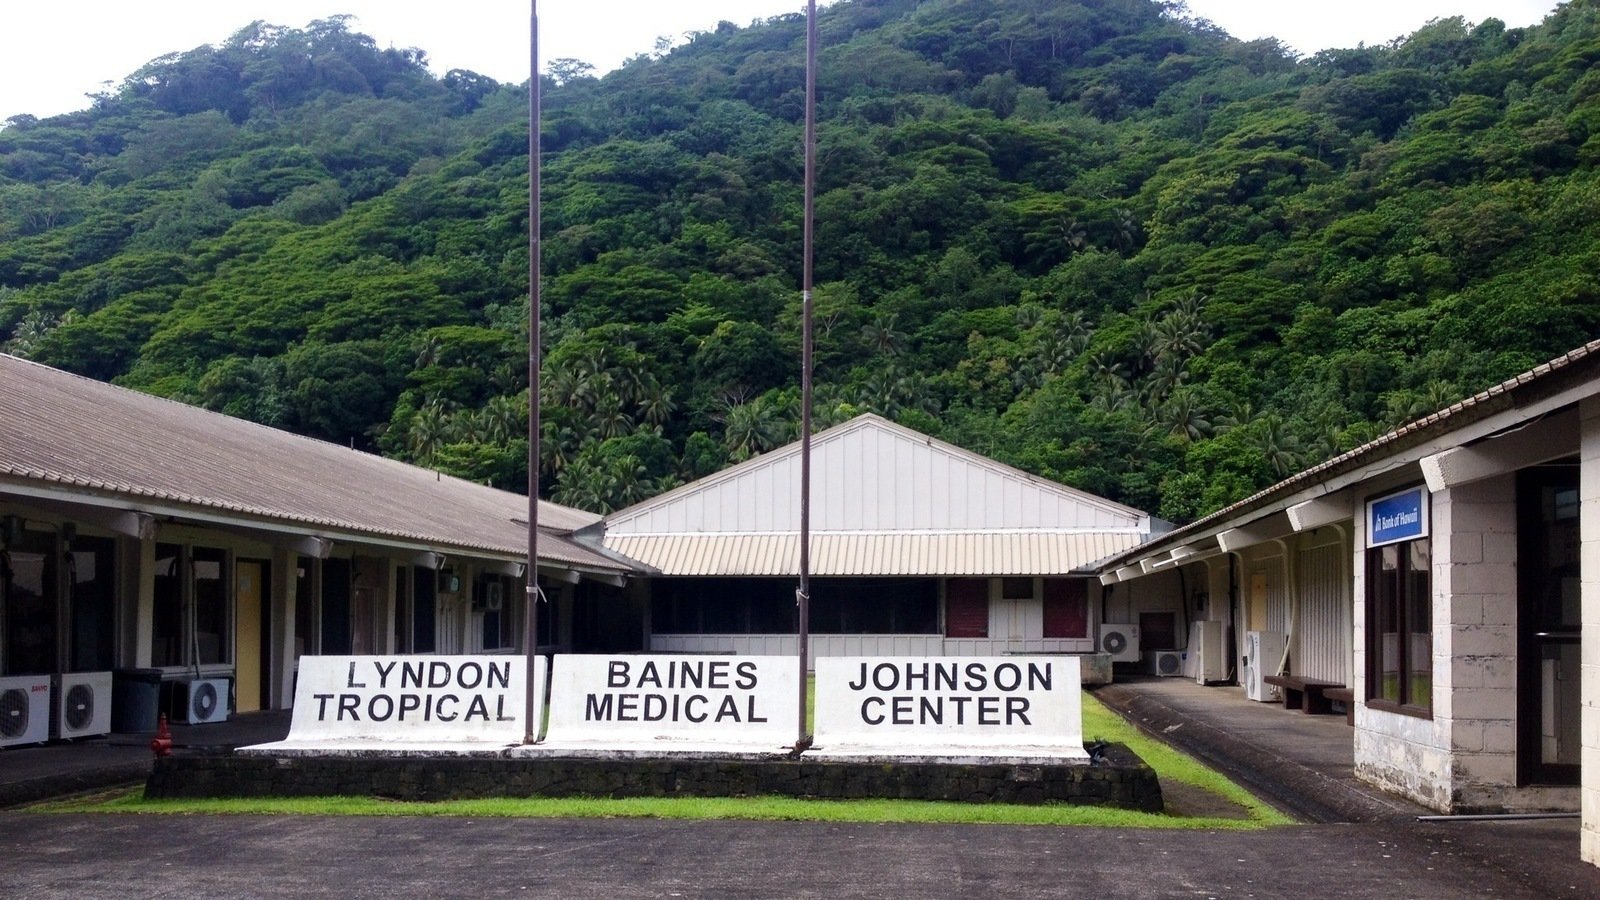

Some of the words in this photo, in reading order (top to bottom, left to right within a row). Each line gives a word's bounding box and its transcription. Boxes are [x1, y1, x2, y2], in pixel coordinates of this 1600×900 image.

[1382, 515, 1394, 530] Bank
[1394, 513, 1400, 527] of
[1400, 507, 1418, 525] Hawaii
[348, 661, 510, 689] LYNDON
[607, 660, 758, 690] BAINES
[848, 662, 1052, 692] JOHNSON
[313, 694, 515, 722] TROPICAL
[585, 693, 768, 723] MEDICAL
[861, 696, 1032, 726] CENTER
